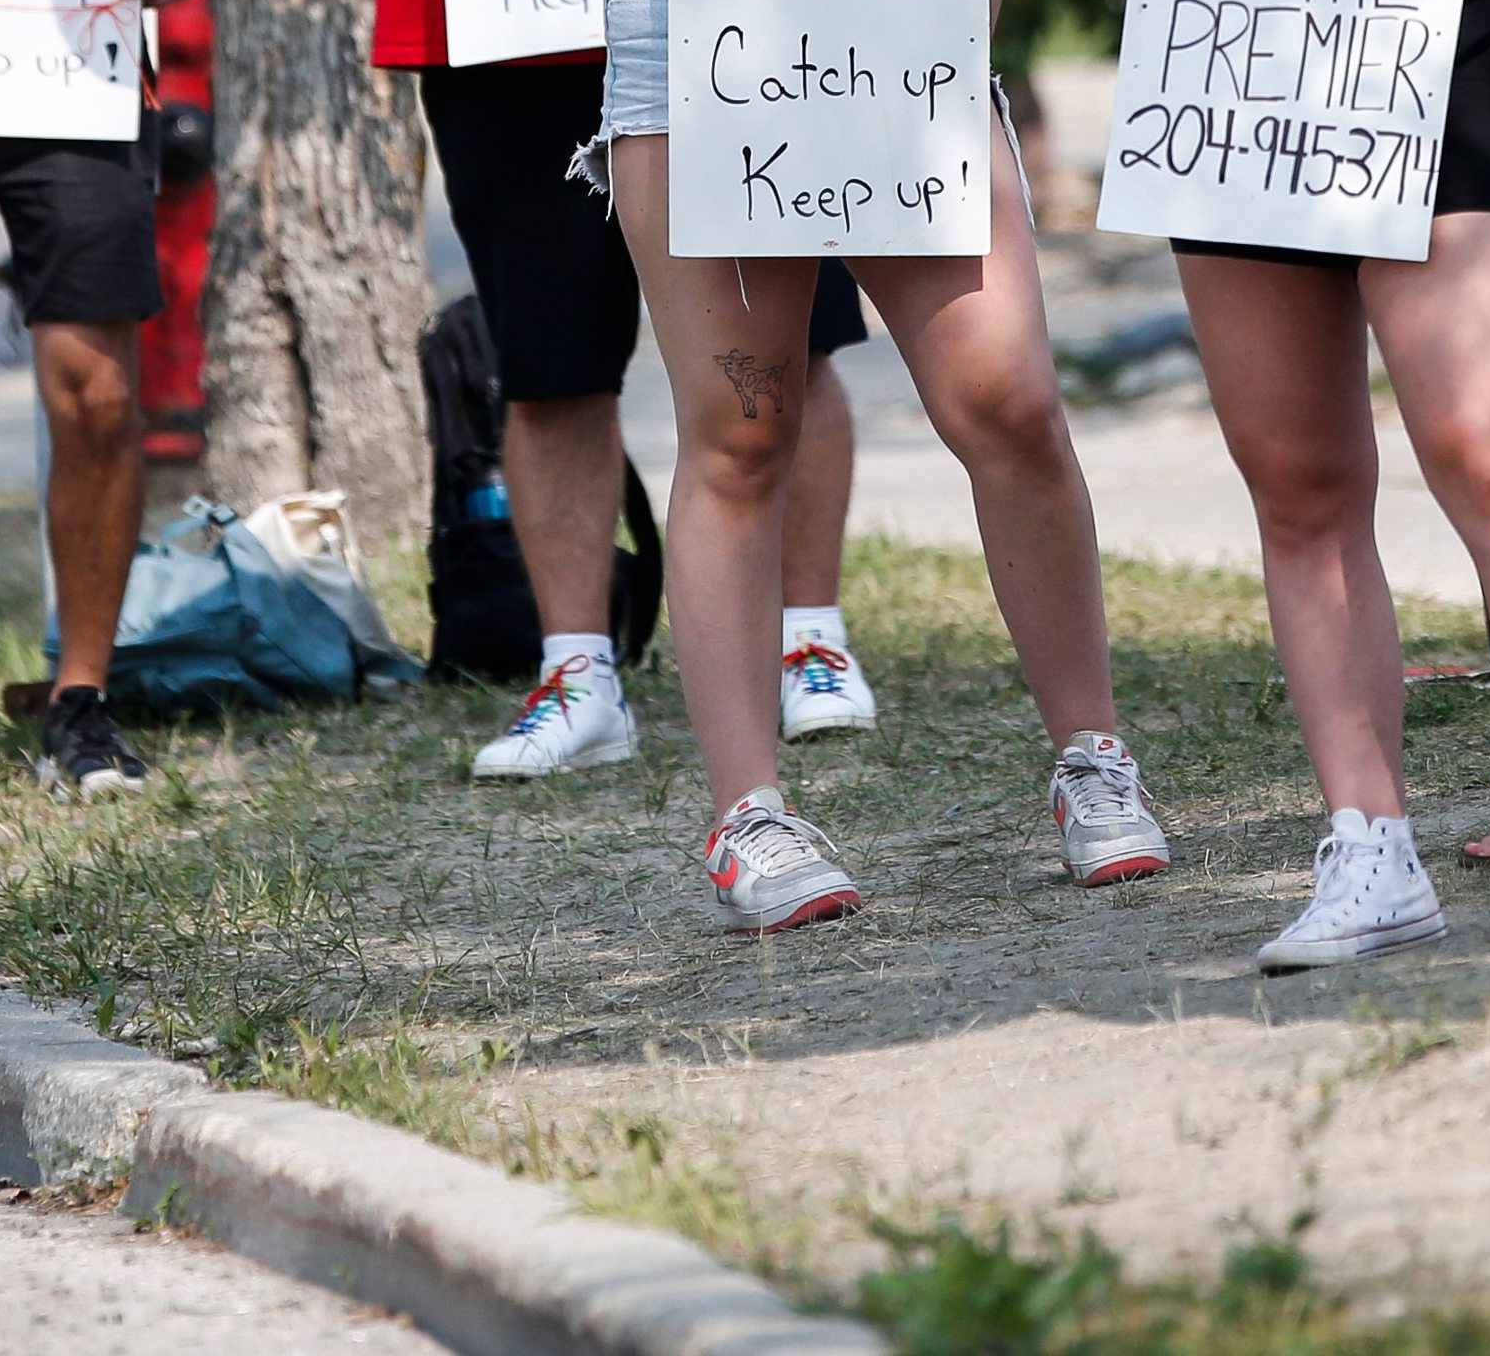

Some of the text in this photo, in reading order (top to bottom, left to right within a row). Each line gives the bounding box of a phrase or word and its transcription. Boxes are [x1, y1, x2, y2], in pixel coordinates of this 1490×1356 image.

[710, 24, 958, 122] Catch up
[741, 141, 970, 234] Keep up!
